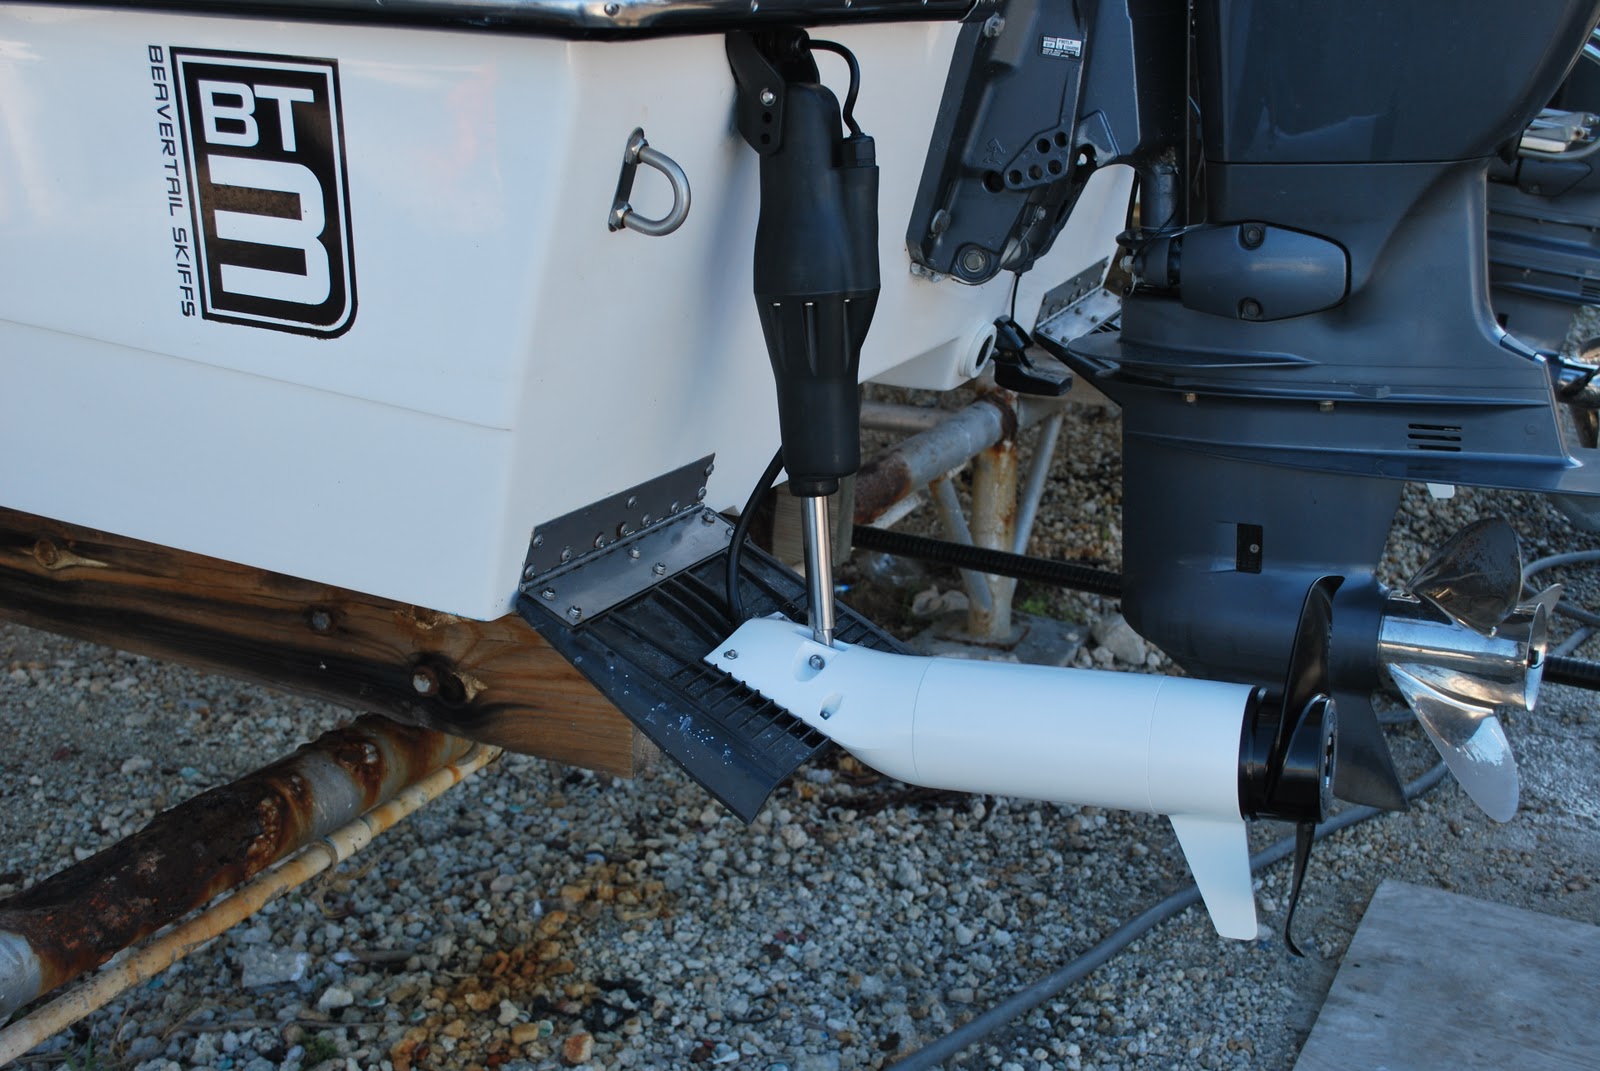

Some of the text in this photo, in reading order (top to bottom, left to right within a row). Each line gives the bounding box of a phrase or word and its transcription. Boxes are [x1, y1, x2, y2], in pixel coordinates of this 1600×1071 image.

[148, 45, 195, 318] BEAVERTAIL SKIFFS
[198, 79, 315, 152] BT
